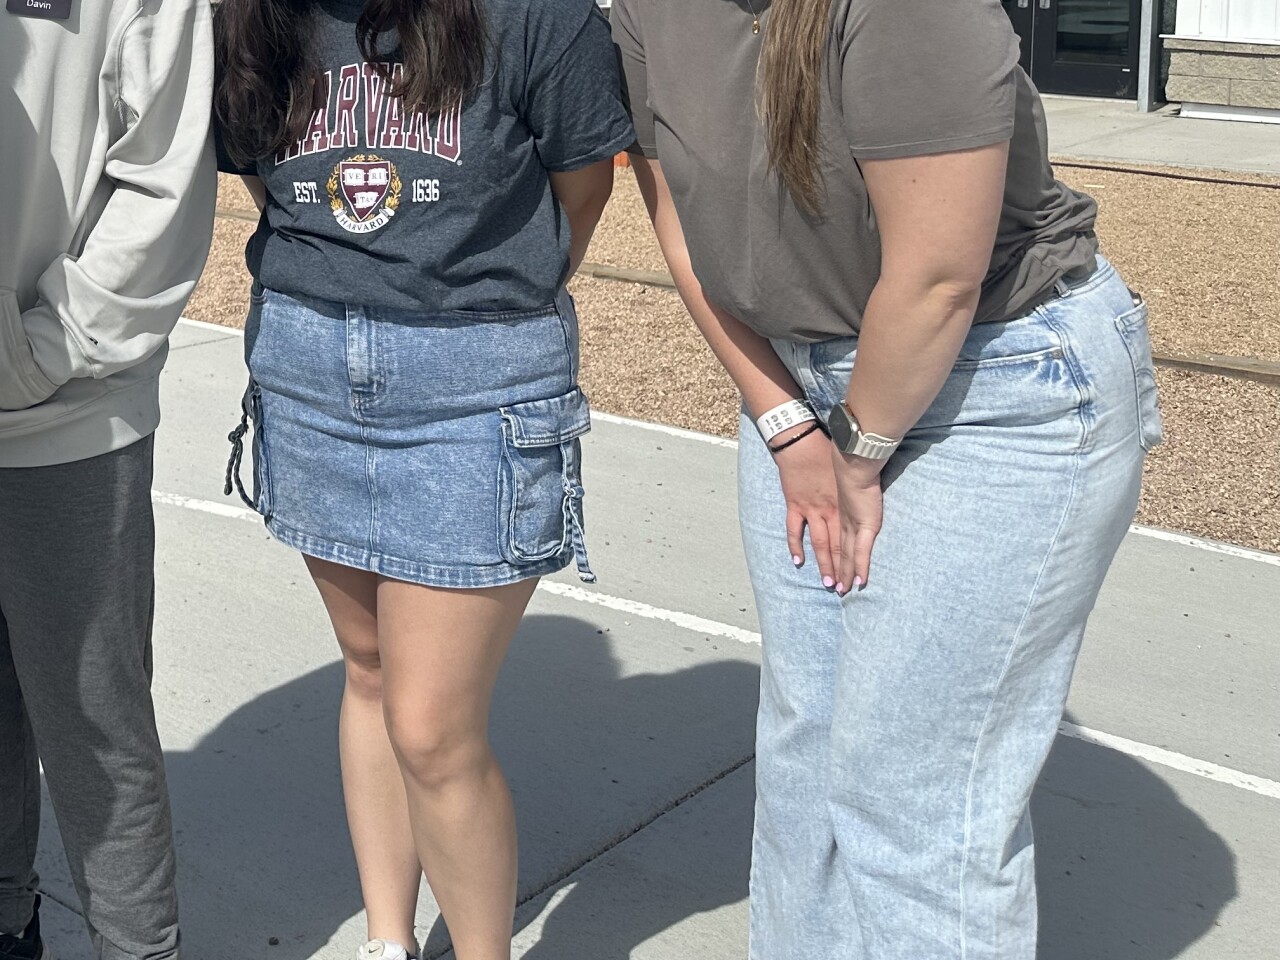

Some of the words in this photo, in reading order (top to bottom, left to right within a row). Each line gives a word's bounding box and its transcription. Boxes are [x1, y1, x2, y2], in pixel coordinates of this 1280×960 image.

[292, 181, 321, 204] EST.
[411, 178, 441, 203] 1636
[339, 217, 385, 232] HARVARD
